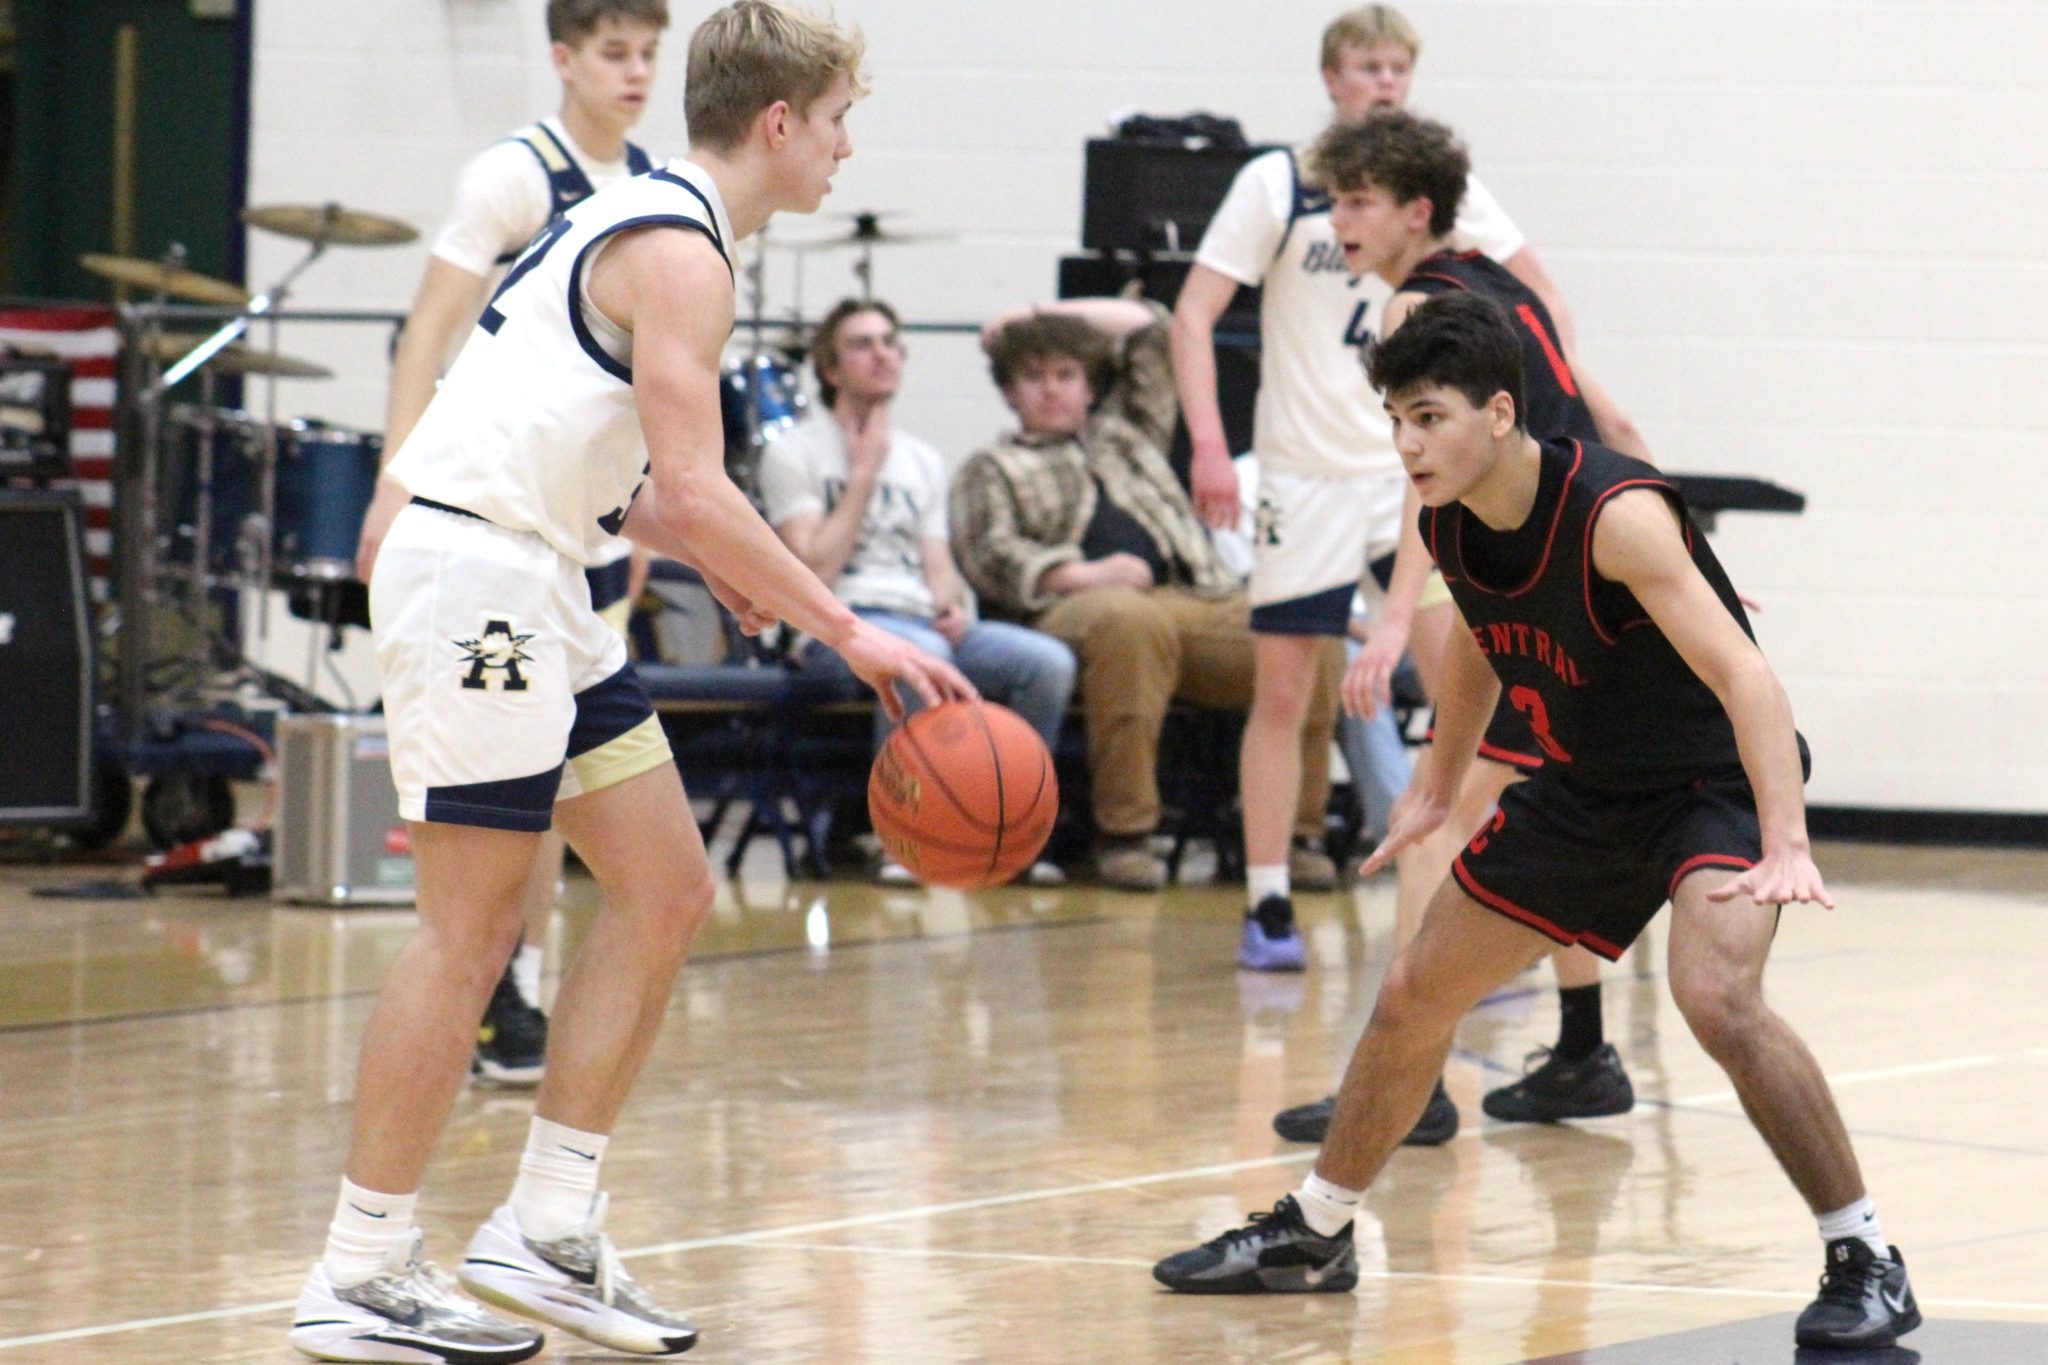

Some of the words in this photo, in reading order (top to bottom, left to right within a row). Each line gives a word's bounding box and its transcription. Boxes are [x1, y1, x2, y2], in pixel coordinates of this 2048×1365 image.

[1515, 303, 1578, 397] 1
[458, 619, 531, 691] A
[1470, 621, 1590, 687] ENTRAL
[1509, 684, 1573, 763] 3
